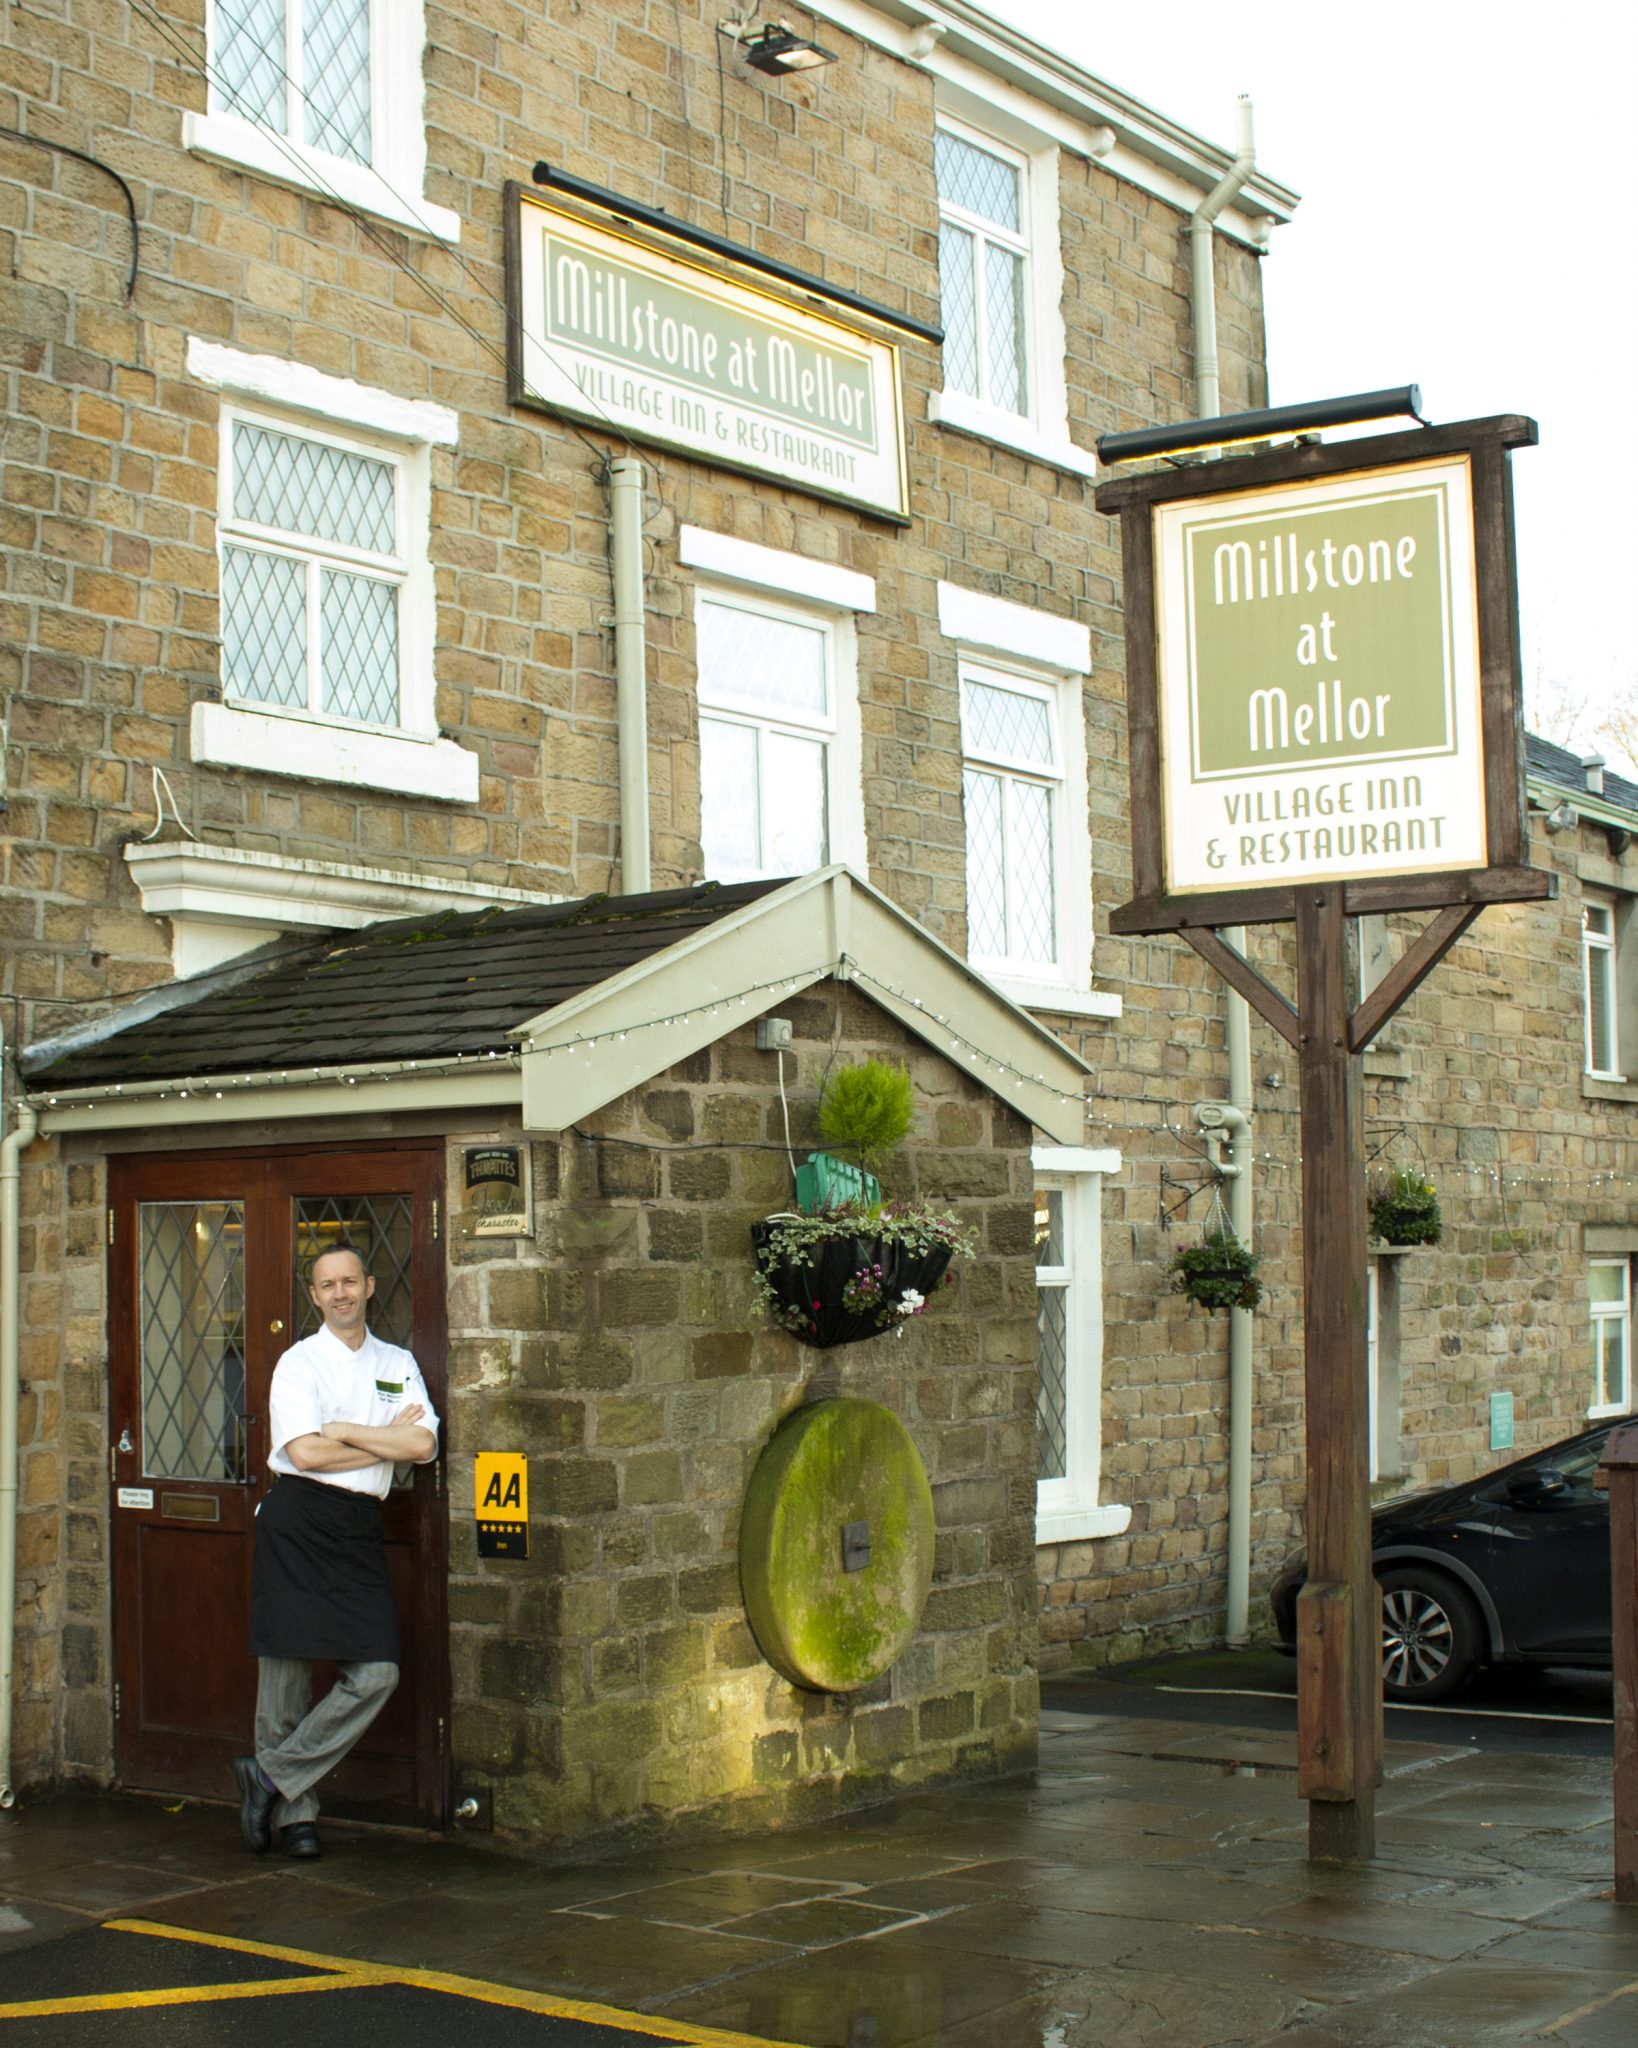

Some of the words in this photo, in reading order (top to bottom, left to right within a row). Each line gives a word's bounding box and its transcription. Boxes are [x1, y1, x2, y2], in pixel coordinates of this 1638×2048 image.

[557, 255, 718, 379] Millstone
[728, 335, 759, 393] at
[766, 334, 865, 433] Mellor
[575, 361, 664, 421] VILLAGE
[714, 411, 729, 441] &
[736, 422, 857, 484] RESTAURANT
[1214, 533, 1416, 604] Millstone
[1296, 611, 1338, 666] at
[1248, 679, 1391, 752] Mellor
[1224, 782, 1354, 826] VILLAGE
[1206, 838, 1227, 870] &
[1240, 816, 1446, 867] RESTAURANT
[483, 1472, 520, 1508] AA
